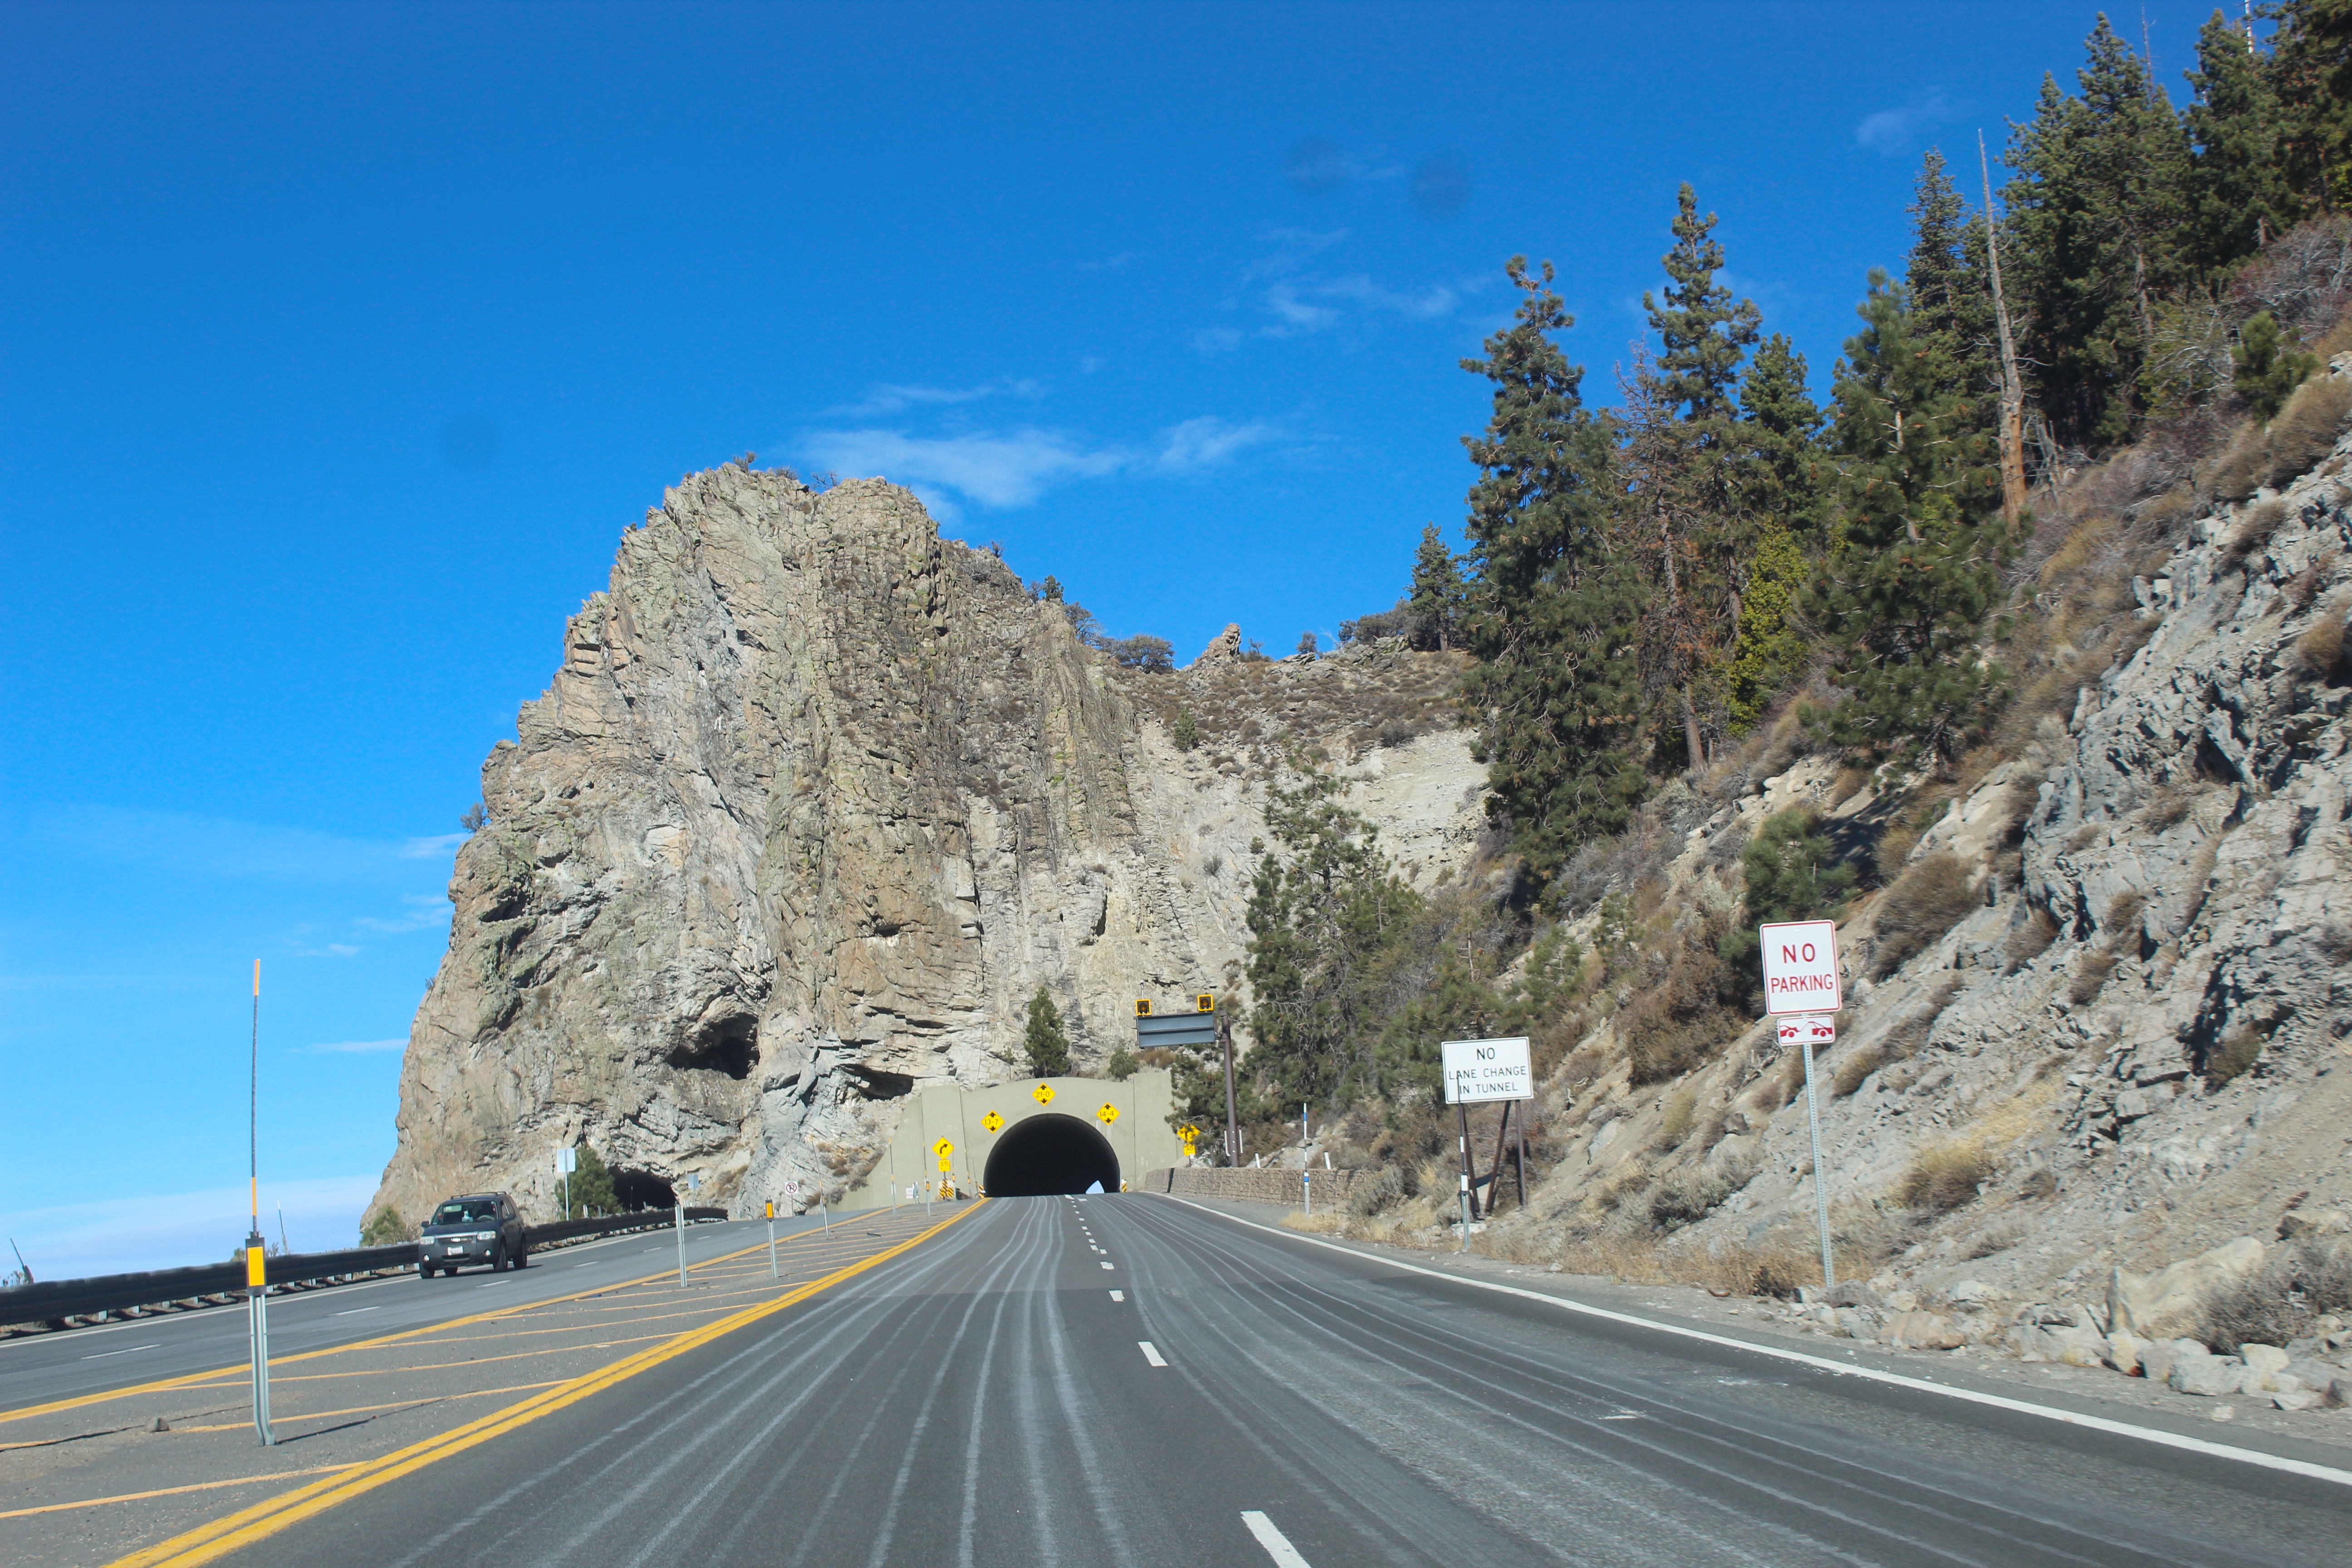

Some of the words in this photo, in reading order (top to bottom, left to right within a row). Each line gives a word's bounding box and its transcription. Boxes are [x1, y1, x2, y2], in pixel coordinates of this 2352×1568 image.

[1782, 943, 1815, 963] NO
[1771, 974, 1833, 993] PARKING
[1476, 1047, 1495, 1060] NO
[1449, 1069, 1477, 1079] LANE
[1483, 1066, 1527, 1078] CHANGE
[1459, 1085, 1470, 1094] IN
[1475, 1082, 1518, 1093] TUNNEL
